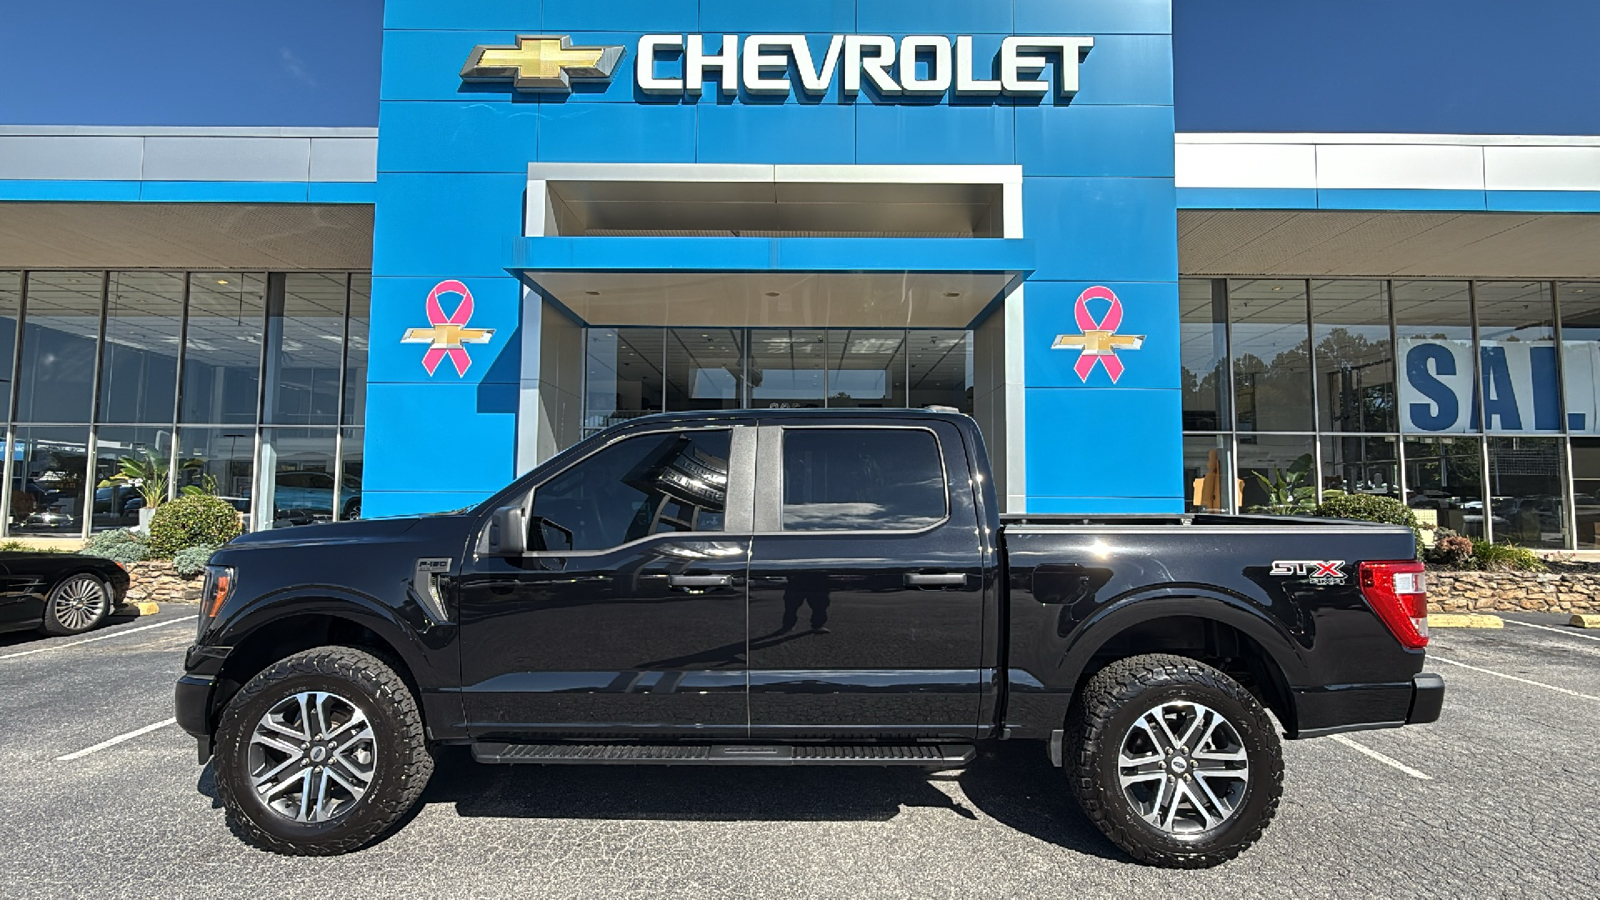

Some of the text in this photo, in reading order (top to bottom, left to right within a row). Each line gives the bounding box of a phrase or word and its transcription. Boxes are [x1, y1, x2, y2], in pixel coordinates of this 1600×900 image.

[635, 34, 1095, 96] CHEVROLET
[1406, 342, 1600, 431] SAL
[1269, 559, 1348, 579] STX
